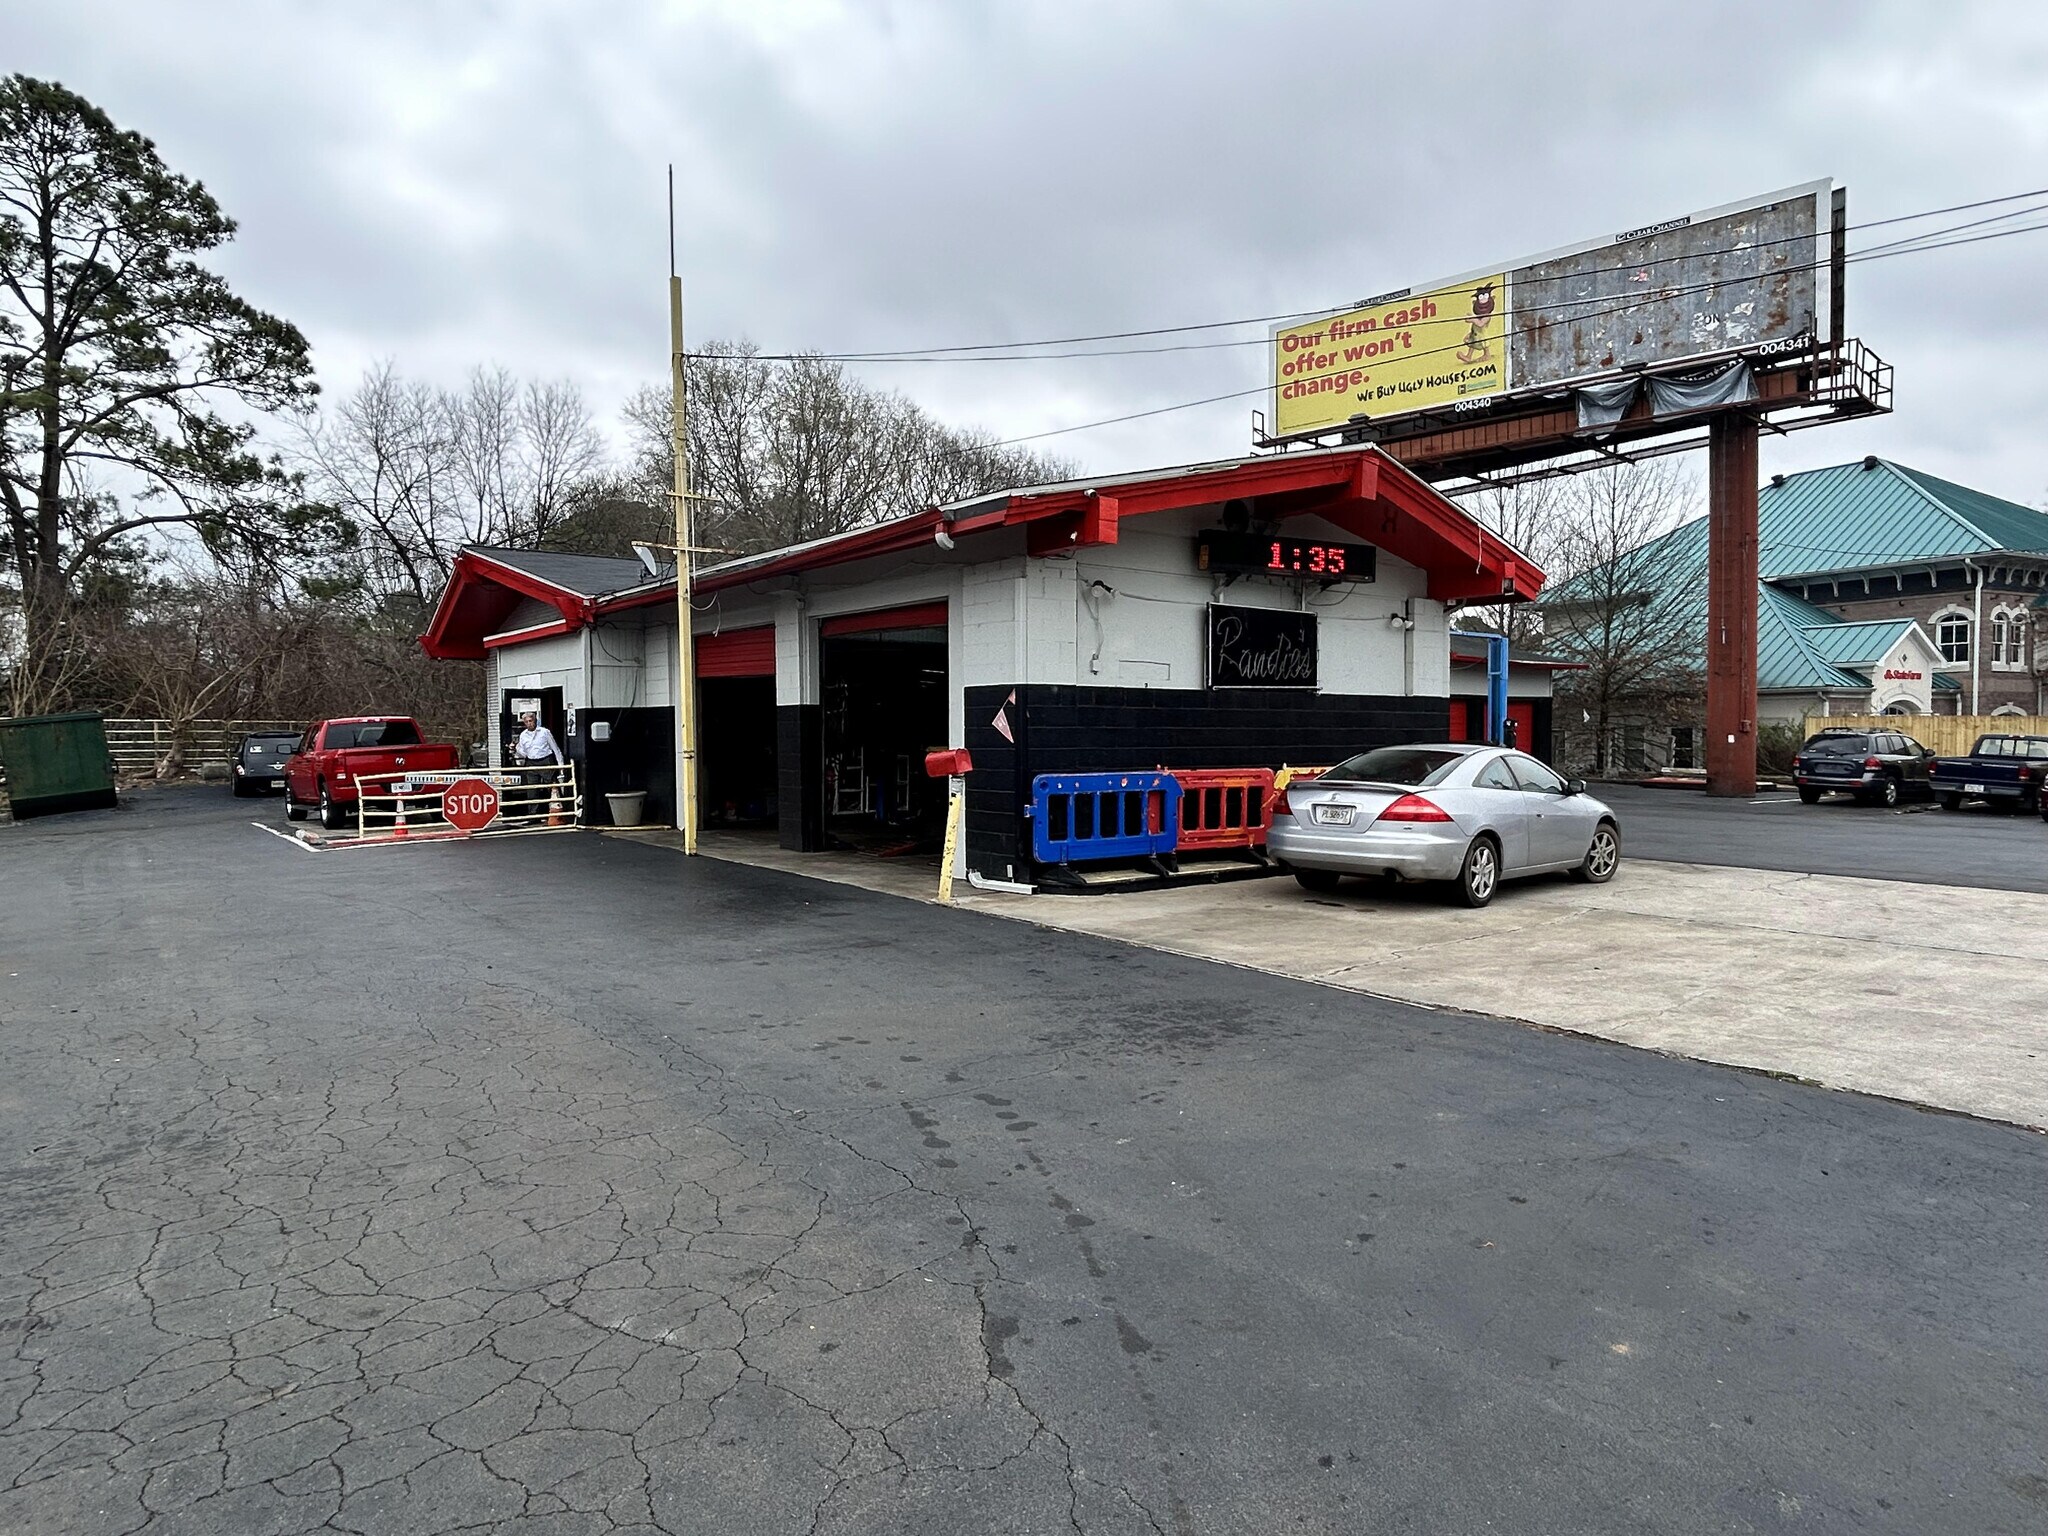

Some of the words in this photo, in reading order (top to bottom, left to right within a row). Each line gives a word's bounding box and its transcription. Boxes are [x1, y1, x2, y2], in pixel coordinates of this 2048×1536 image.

[1282, 331, 1325, 353] Our
[1328, 315, 1377, 342] firm
[1383, 299, 1437, 327] cash
[1282, 350, 1338, 377] offer
[1343, 331, 1412, 362] won't
[1759, 337, 1810, 355] 004341
[1282, 370, 1370, 400] change.
[1455, 398, 1491, 412] 004340
[1268, 543, 1345, 573] 1:35
[447, 794, 495, 815] STOP
